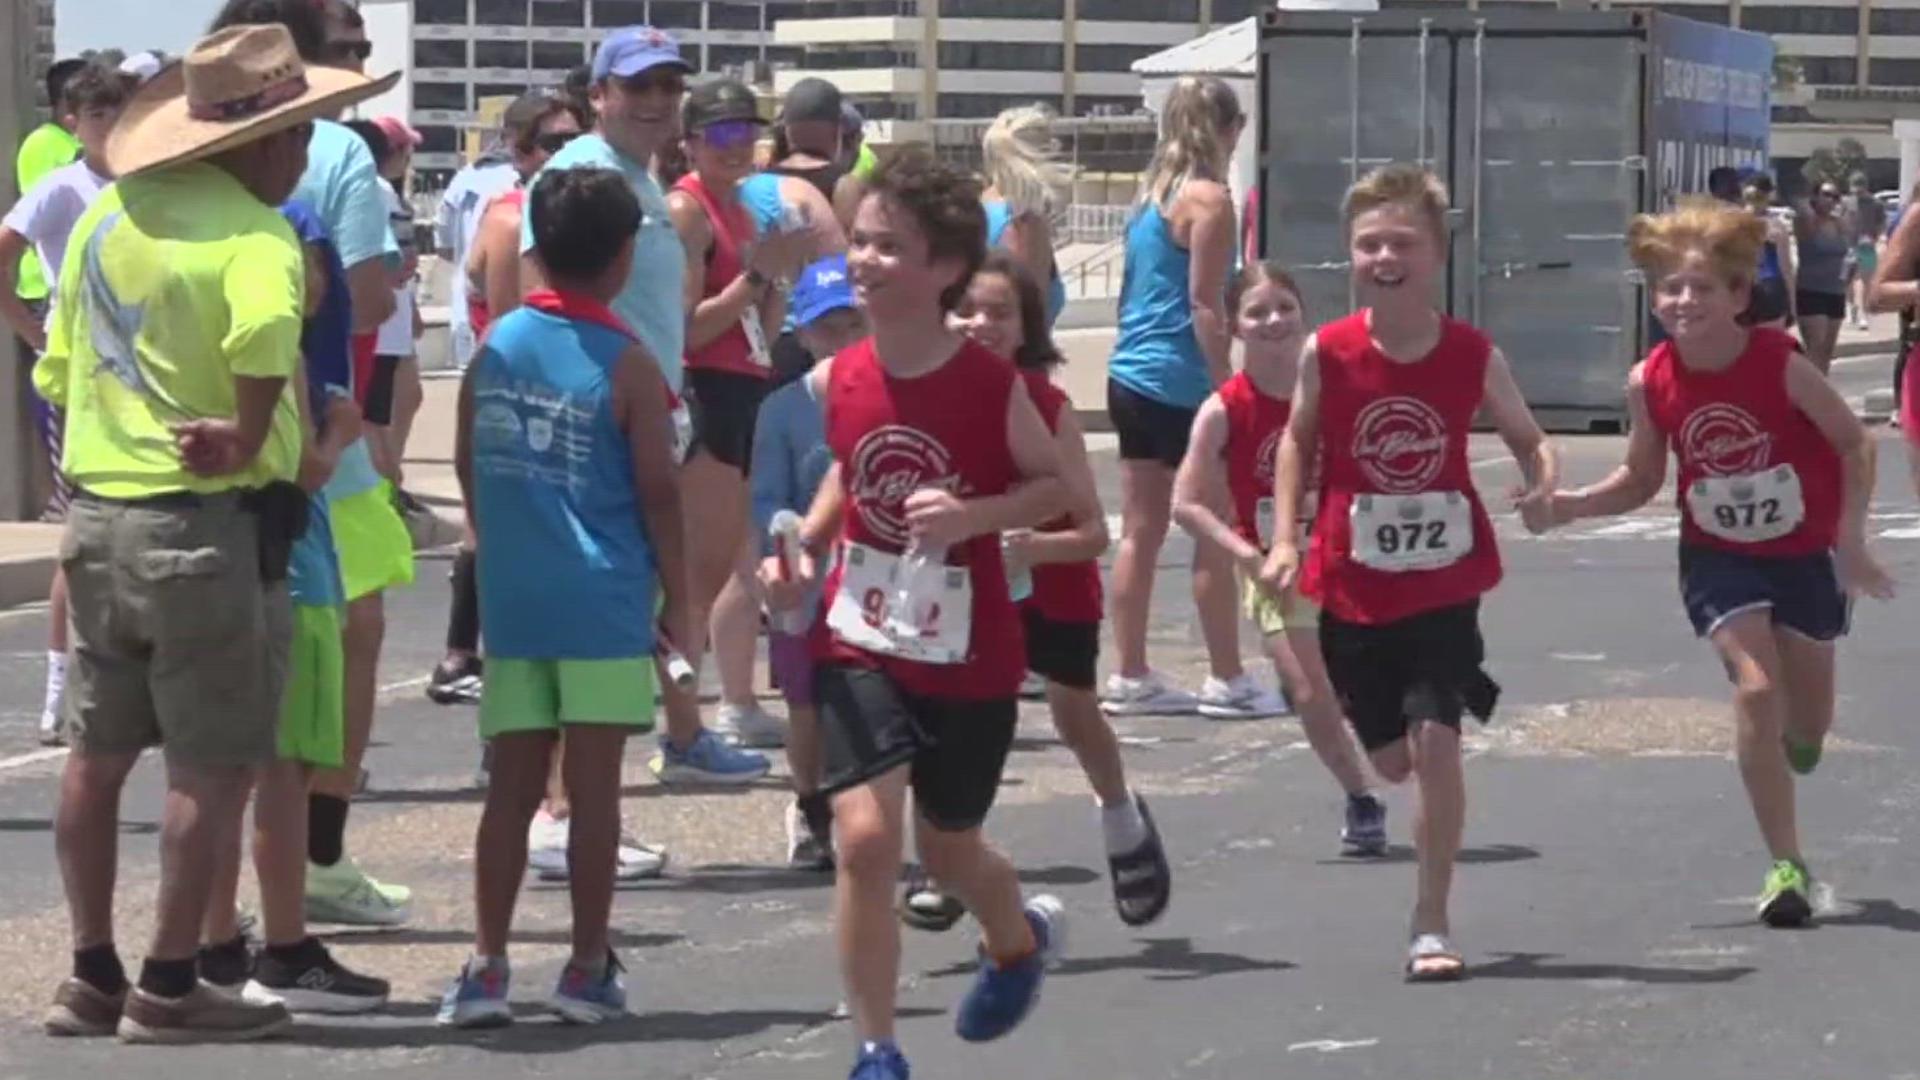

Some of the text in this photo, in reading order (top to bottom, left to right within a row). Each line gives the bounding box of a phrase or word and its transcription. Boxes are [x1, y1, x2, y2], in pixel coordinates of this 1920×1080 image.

[1715, 499, 1782, 528] 972
[1377, 522, 1447, 553] 972
[863, 587, 942, 637] 92
